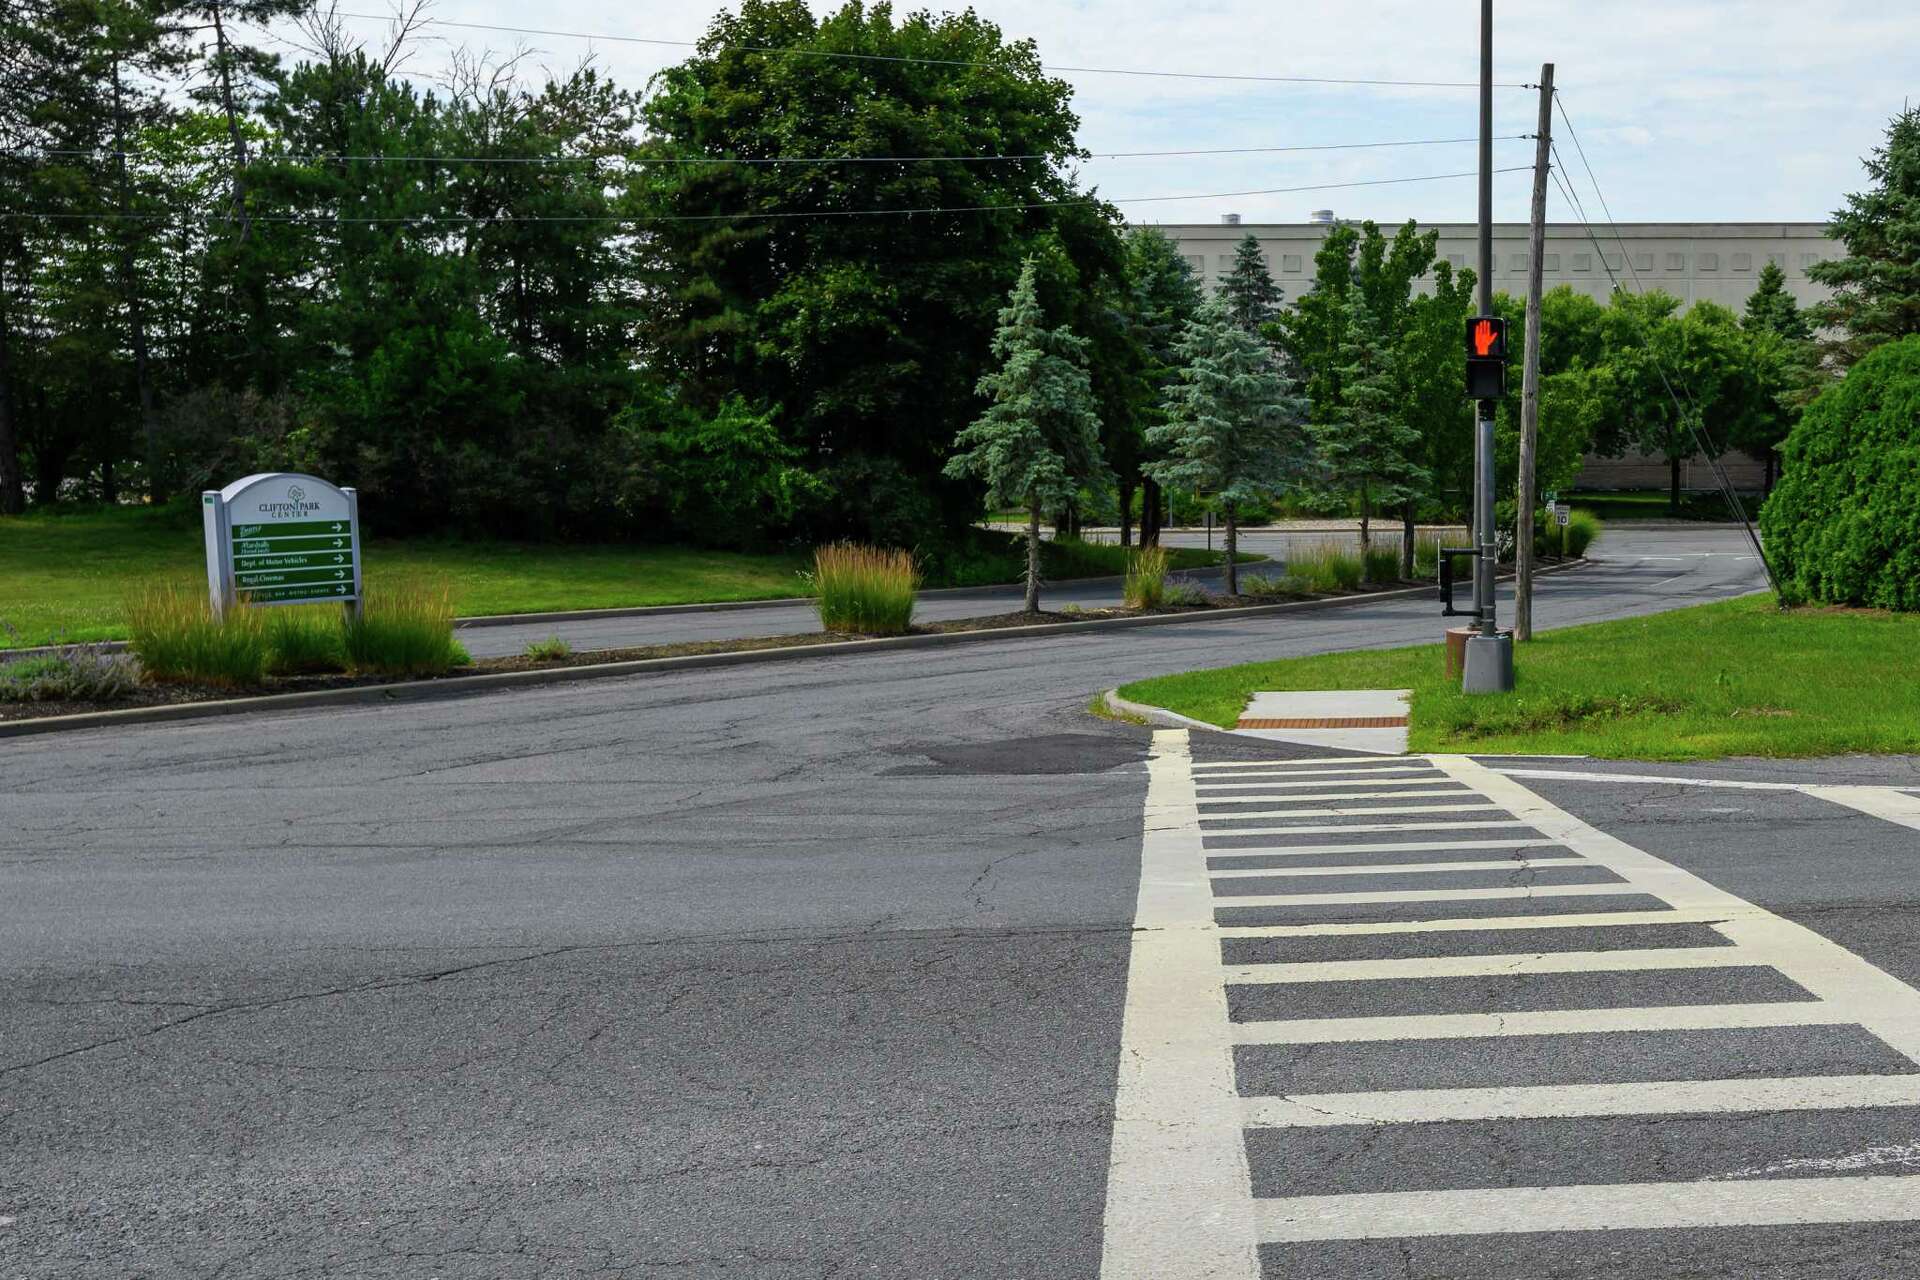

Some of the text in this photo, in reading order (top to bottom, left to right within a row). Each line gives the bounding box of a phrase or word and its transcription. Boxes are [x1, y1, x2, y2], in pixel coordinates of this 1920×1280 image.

[259, 502, 320, 512] CLIFTON PARK
[1557, 515, 1567, 523] 10
[283, 556, 308, 564] Vehicles
